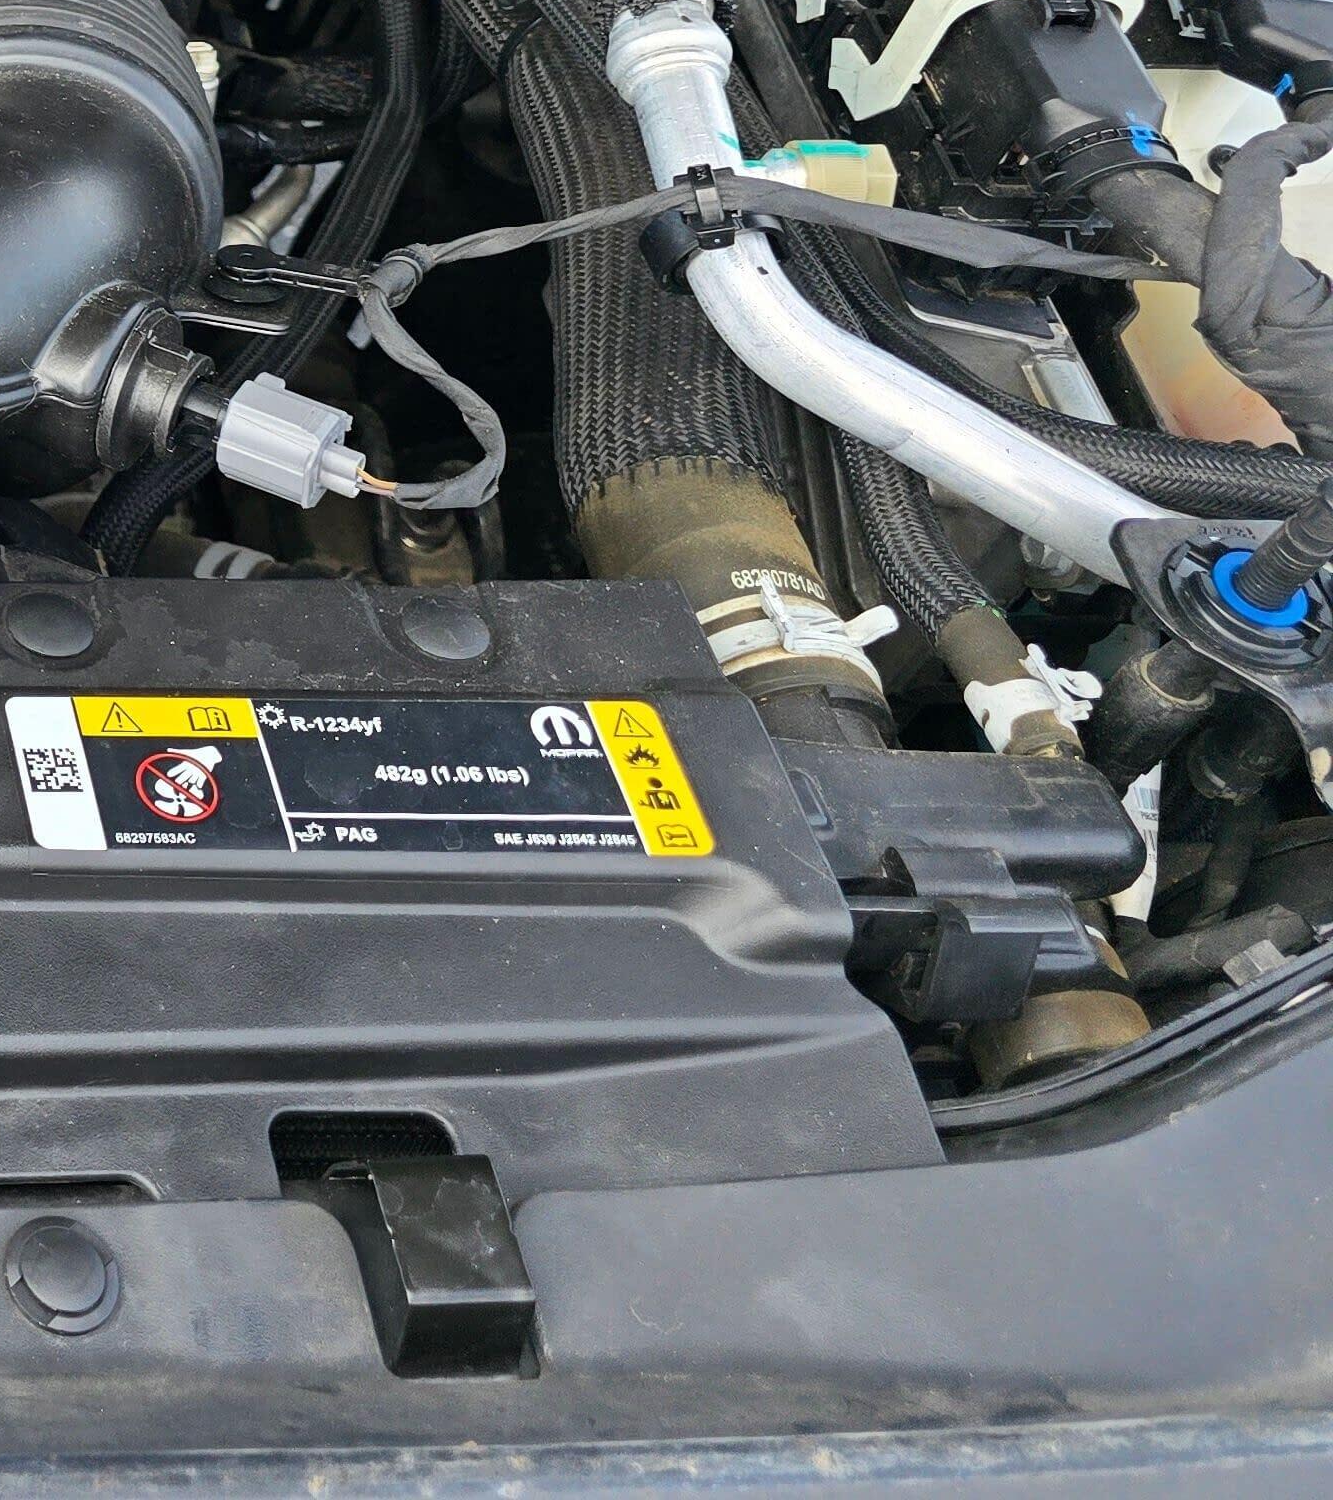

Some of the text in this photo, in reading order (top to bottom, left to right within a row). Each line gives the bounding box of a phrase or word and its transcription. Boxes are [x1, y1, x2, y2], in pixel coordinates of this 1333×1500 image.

[289, 715, 382, 737] R-1234yf
[374, 764, 531, 787] 482g (1.06 lbs)
[334, 826, 378, 843] PAG
[493, 832, 524, 846] SAE
[558, 833, 598, 847] J2842
[598, 833, 638, 848] J2845
